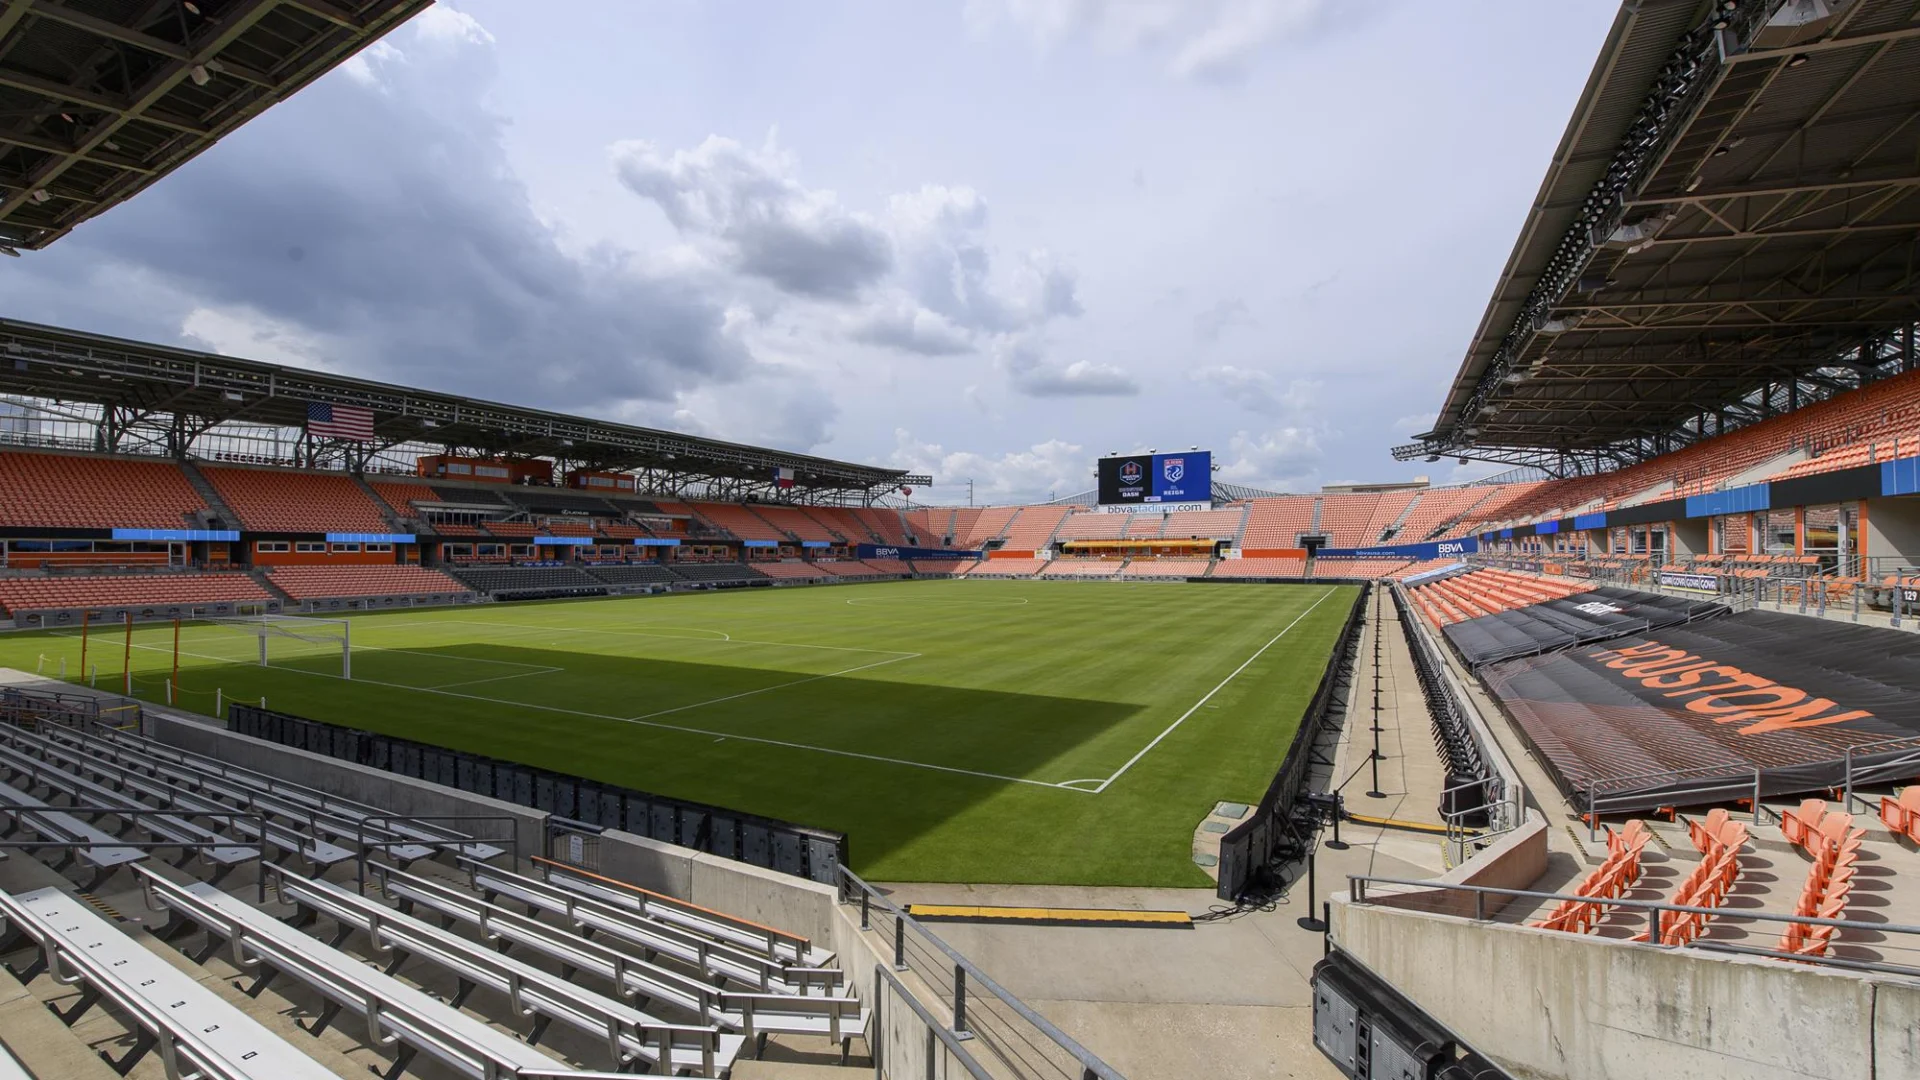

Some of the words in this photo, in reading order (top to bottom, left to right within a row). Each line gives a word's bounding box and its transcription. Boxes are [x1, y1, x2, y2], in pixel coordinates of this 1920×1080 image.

[1107, 503, 1202, 514] bbvastadium.com
[1438, 542, 1464, 552] BBVA
[1673, 577, 1686, 586] GOYA
[1686, 578, 1699, 587] GOYA
[1700, 579, 1716, 590] GOYA
[1904, 590, 1917, 601] 129
[1588, 641, 1874, 735] HOUSTON
